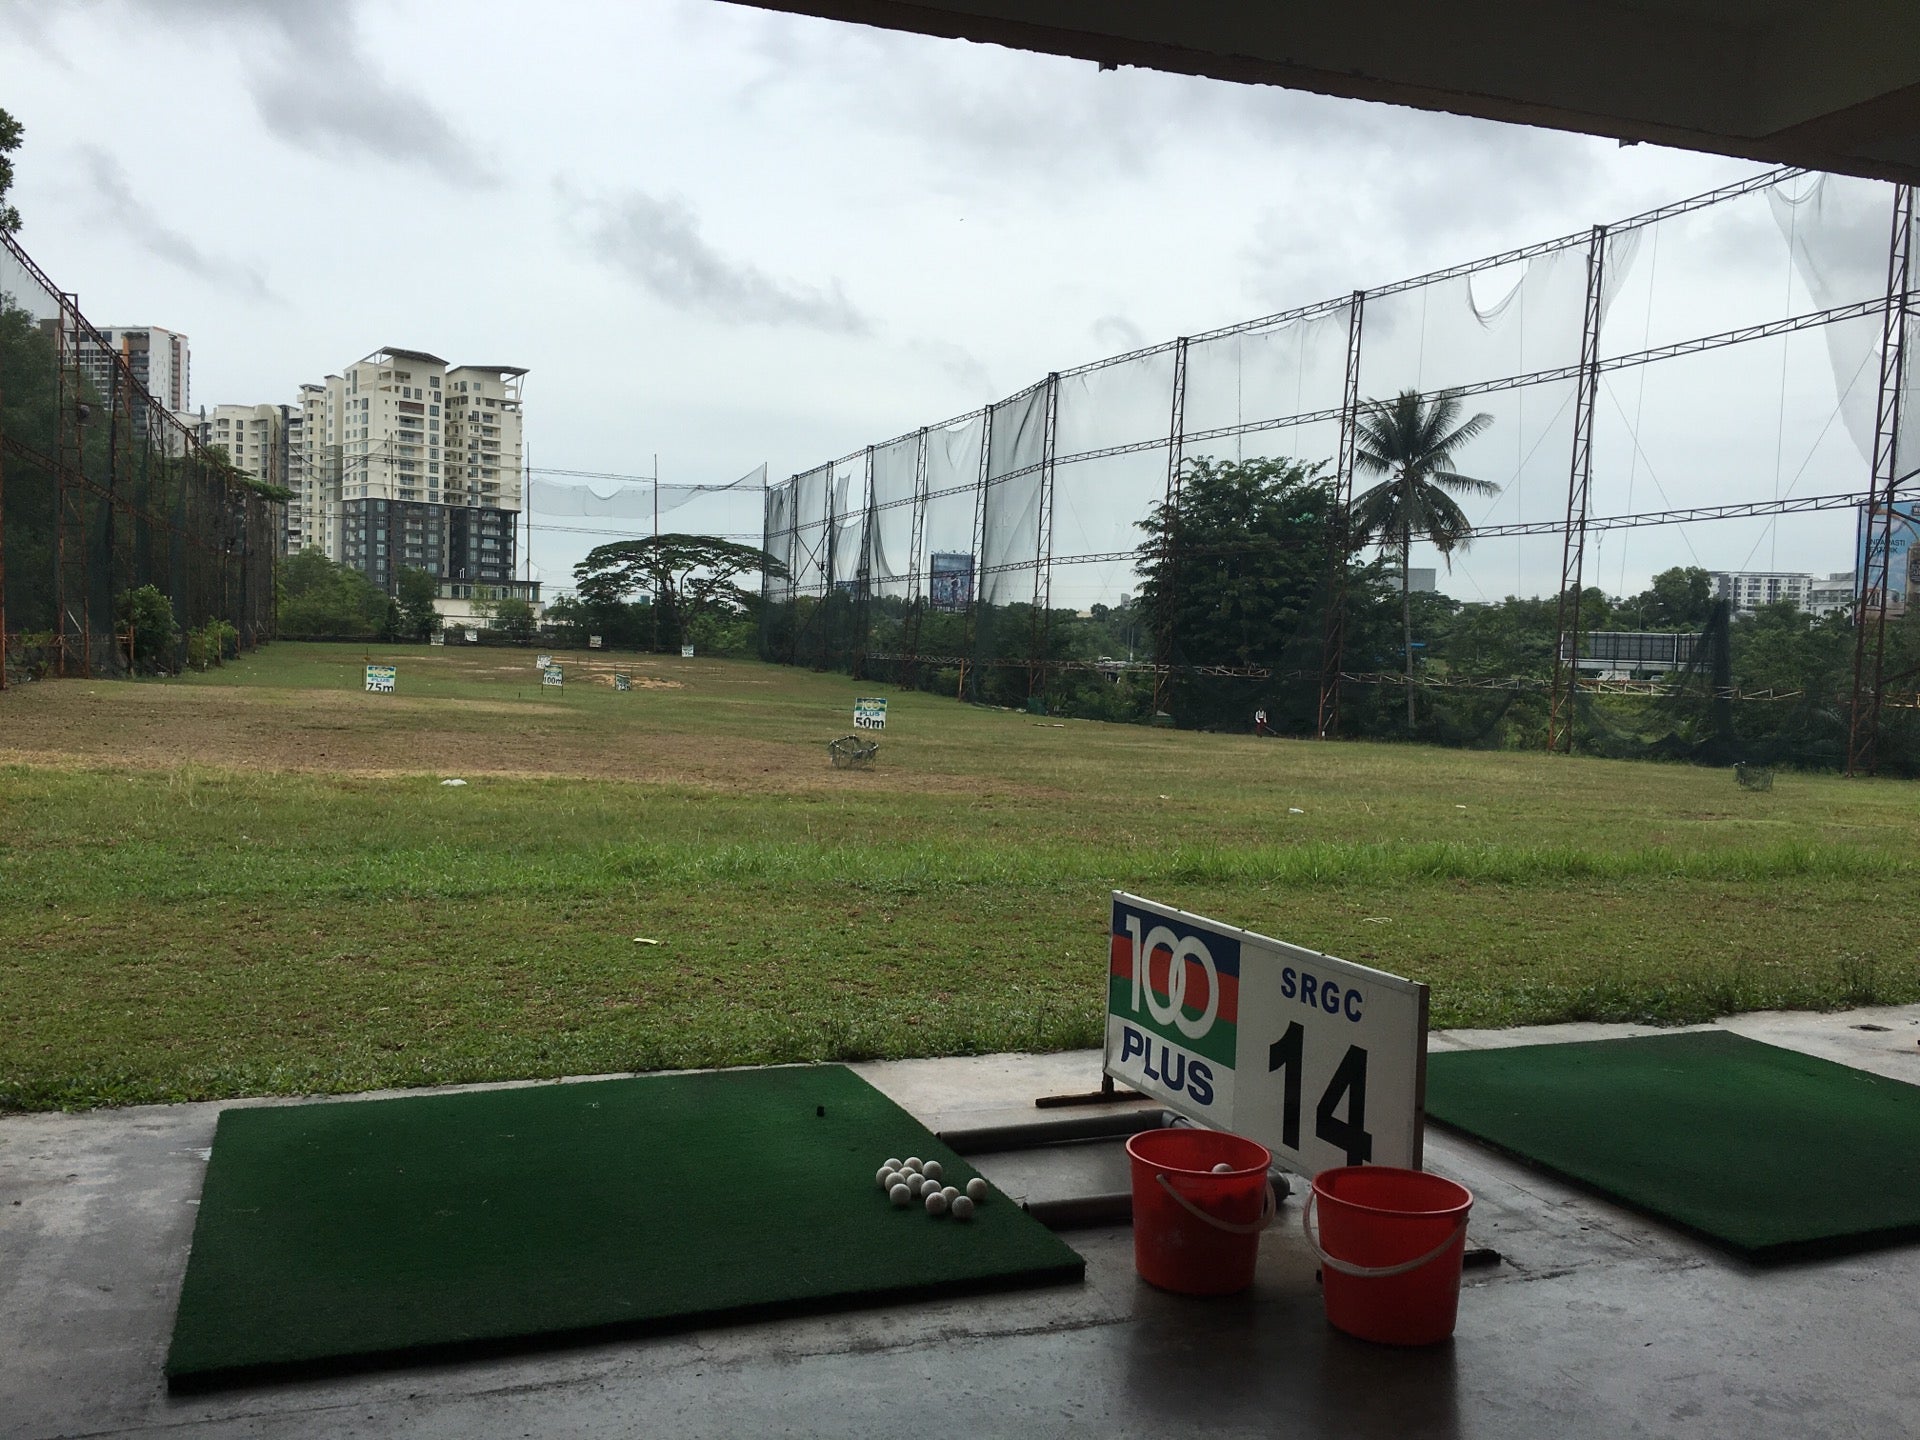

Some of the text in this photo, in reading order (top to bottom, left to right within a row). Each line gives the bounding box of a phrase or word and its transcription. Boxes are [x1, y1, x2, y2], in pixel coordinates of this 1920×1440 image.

[367, 682, 394, 692] 75m
[543, 676, 563, 685] 100m
[855, 717, 885, 729] 50m
[1125, 913, 1219, 1039] 100
[1280, 967, 1363, 1022] SRGC
[1121, 1025, 1214, 1106] PLUS
[1268, 1020, 1372, 1166] 14
